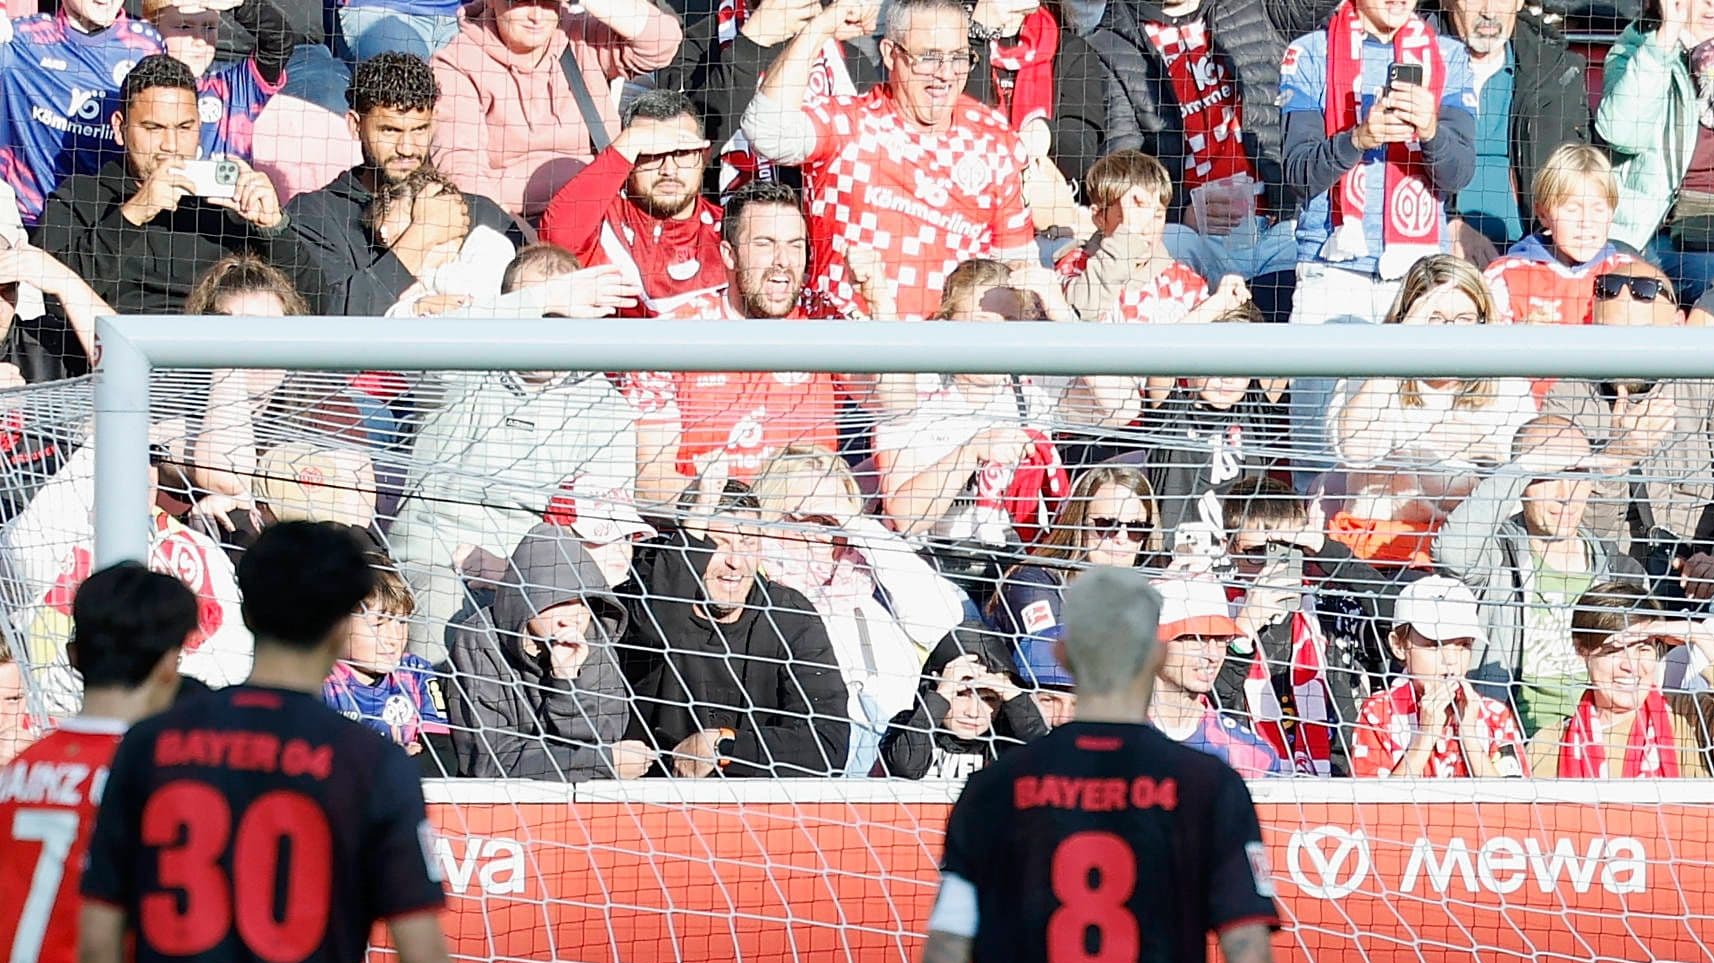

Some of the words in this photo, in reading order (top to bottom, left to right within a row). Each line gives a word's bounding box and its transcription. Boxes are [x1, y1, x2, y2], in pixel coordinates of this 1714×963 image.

[156, 730, 279, 771] BAYER
[282, 737, 333, 779] 04
[1013, 776, 1127, 812] BAYER
[1129, 776, 1180, 809] 04
